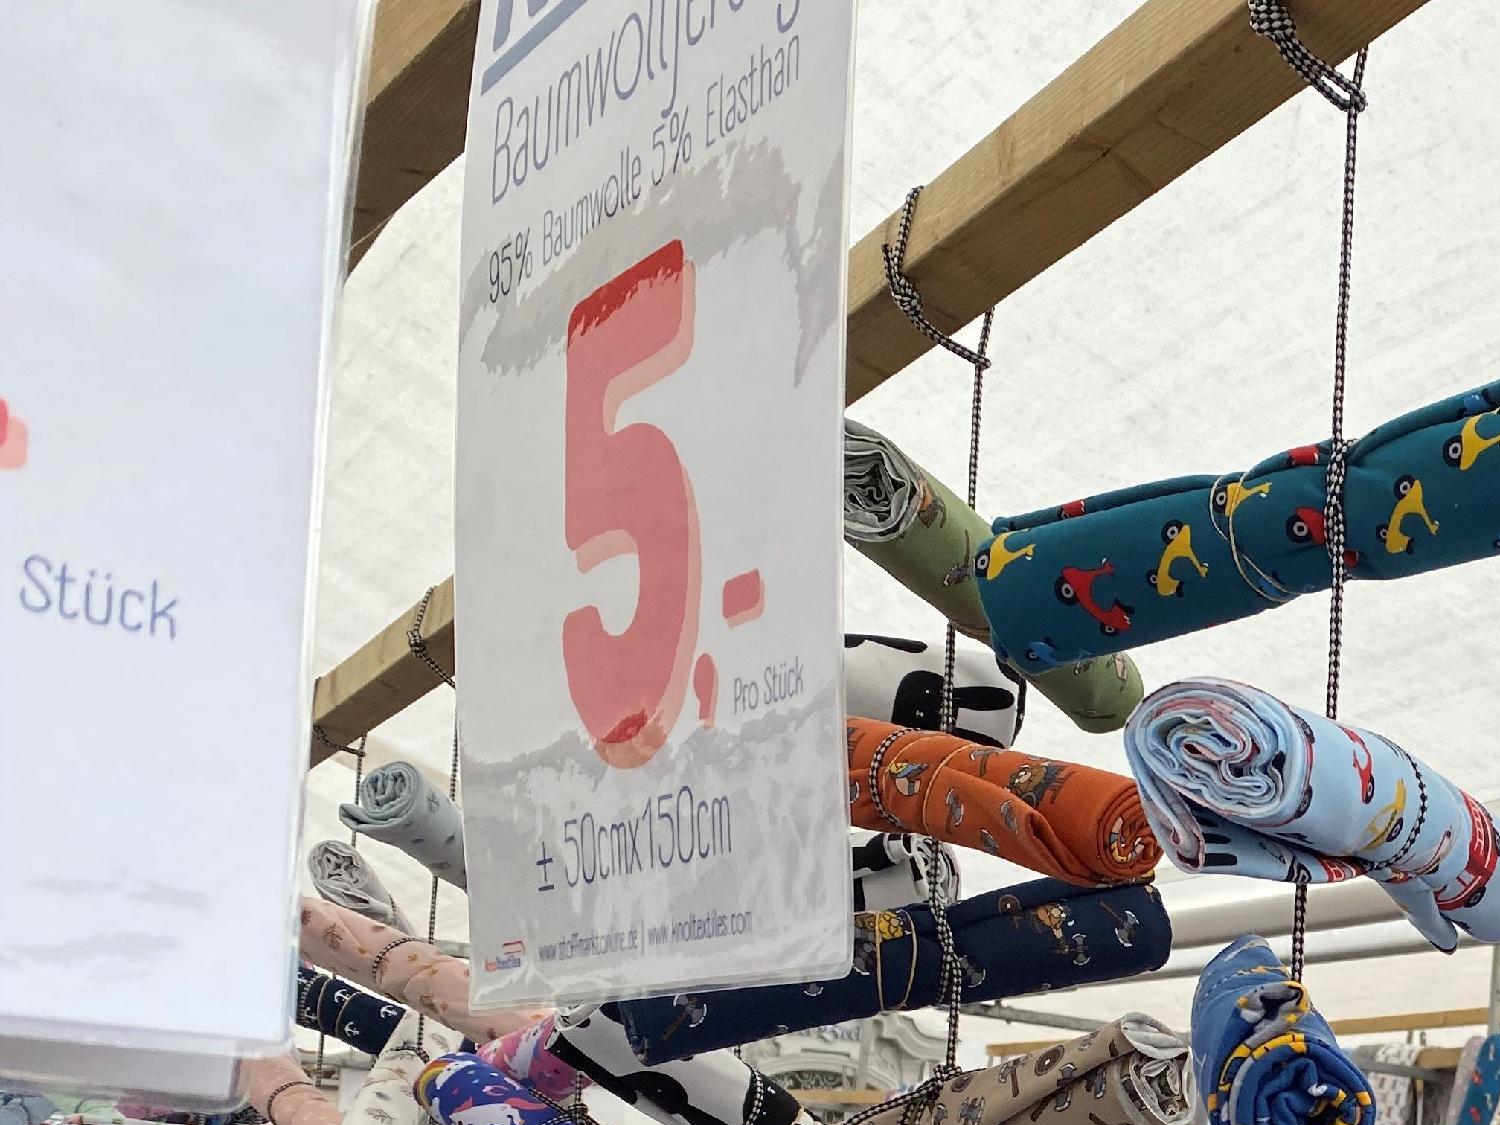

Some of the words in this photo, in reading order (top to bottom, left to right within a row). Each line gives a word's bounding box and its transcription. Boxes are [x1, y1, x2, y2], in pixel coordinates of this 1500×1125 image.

[489, 227, 533, 304] 95%
[542, 146, 641, 266] Baumwolle
[651, 105, 692, 186] 5%
[706, 35, 799, 148] Elasthan
[19, 553, 178, 640] Stück
[733, 676, 759, 716] Pro
[763, 656, 804, 707] Stück
[563, 785, 732, 888] 50cmx150cm
